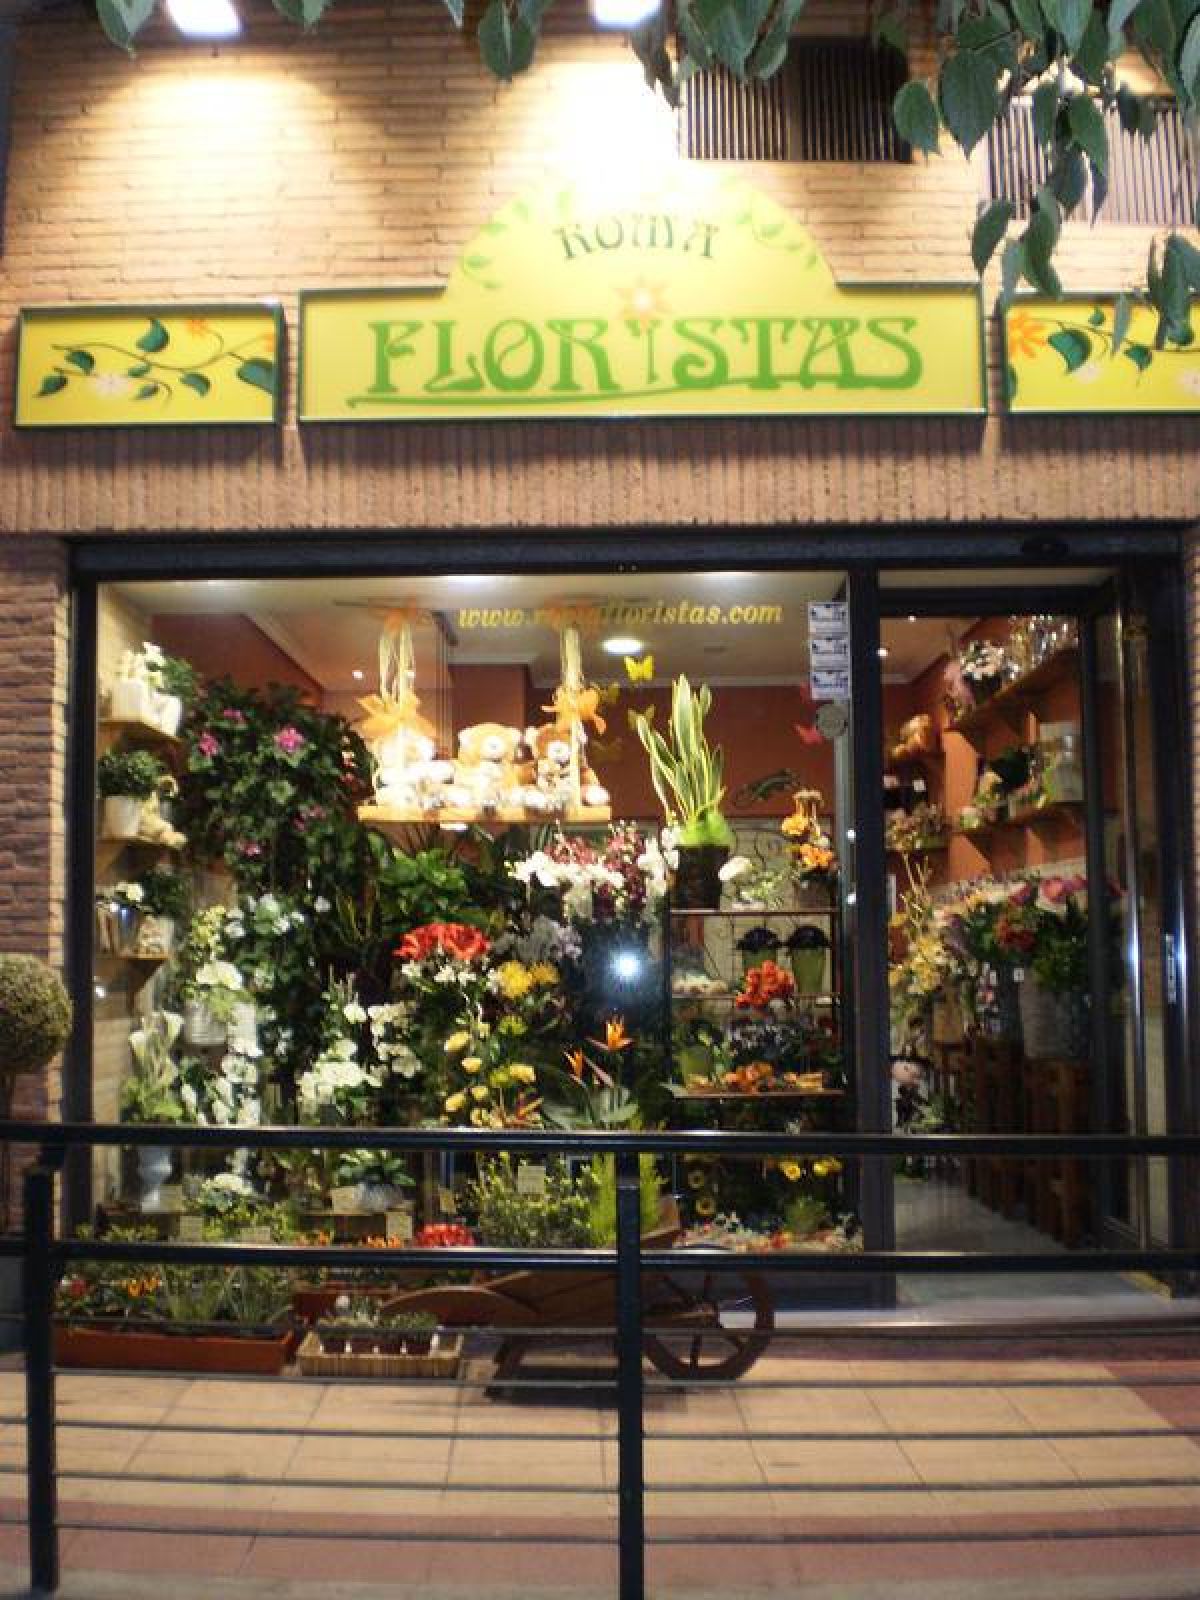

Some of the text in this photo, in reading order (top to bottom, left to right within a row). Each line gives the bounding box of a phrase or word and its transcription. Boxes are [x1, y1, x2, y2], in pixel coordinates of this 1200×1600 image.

[552, 213, 720, 260] ROMA
[366, 316, 925, 394] FLORISTAS
[457, 600, 784, 627] www.rfloristas.com
